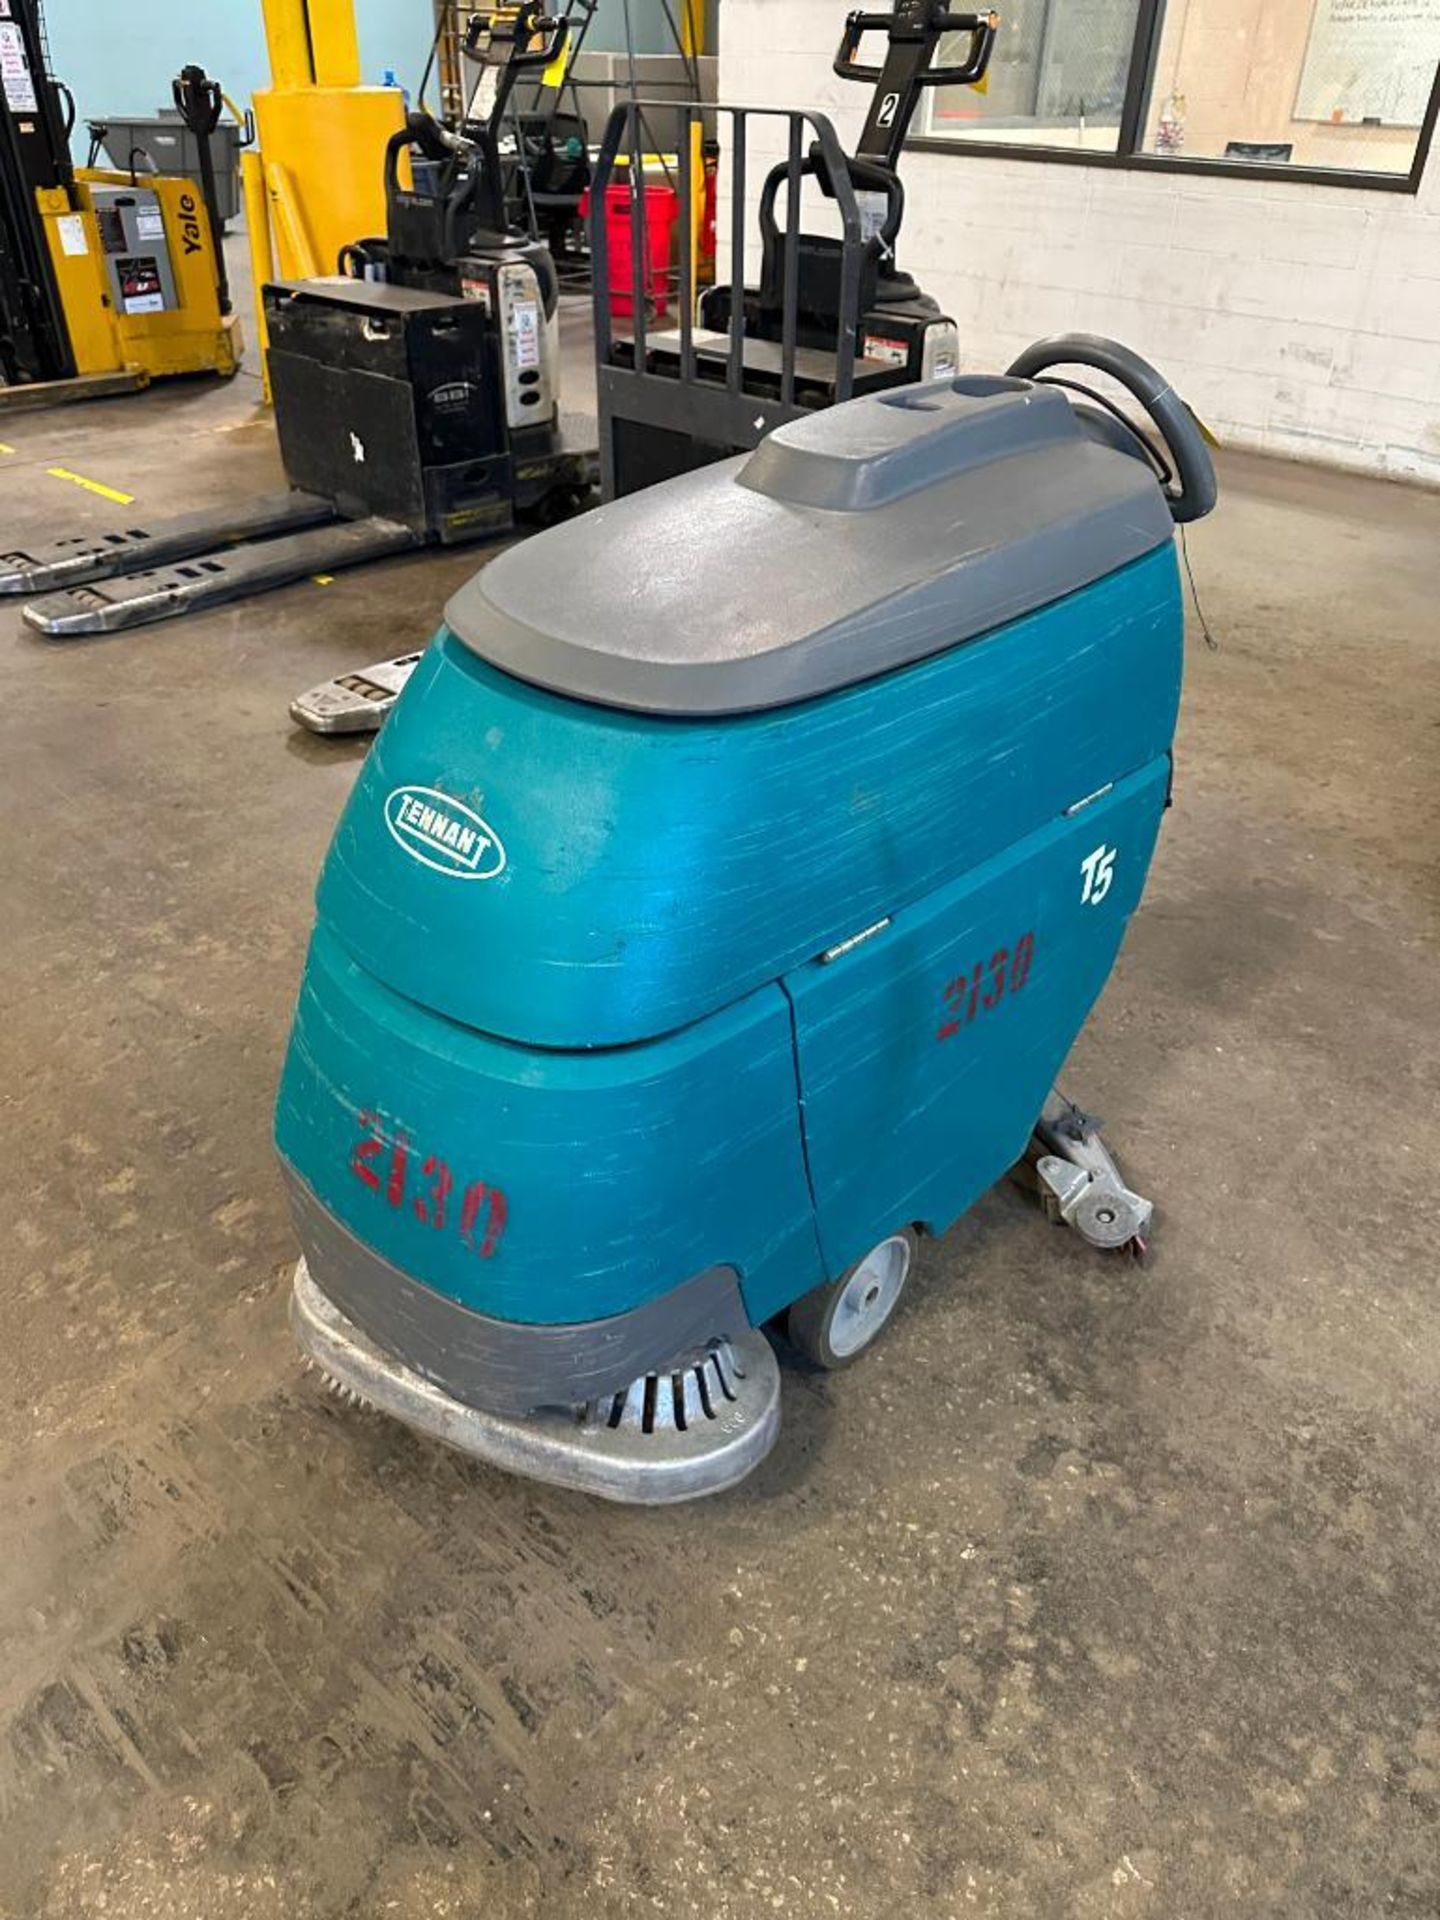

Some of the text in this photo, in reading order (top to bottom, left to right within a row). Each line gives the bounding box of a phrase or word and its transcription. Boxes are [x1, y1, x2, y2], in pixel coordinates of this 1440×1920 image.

[879, 95, 896, 124] 2
[177, 194, 202, 255] Yale
[395, 794, 491, 869] TENNANT
[1080, 844, 1117, 905] T5
[937, 931, 1035, 1041] 2130
[353, 1108, 507, 1259] 2130
